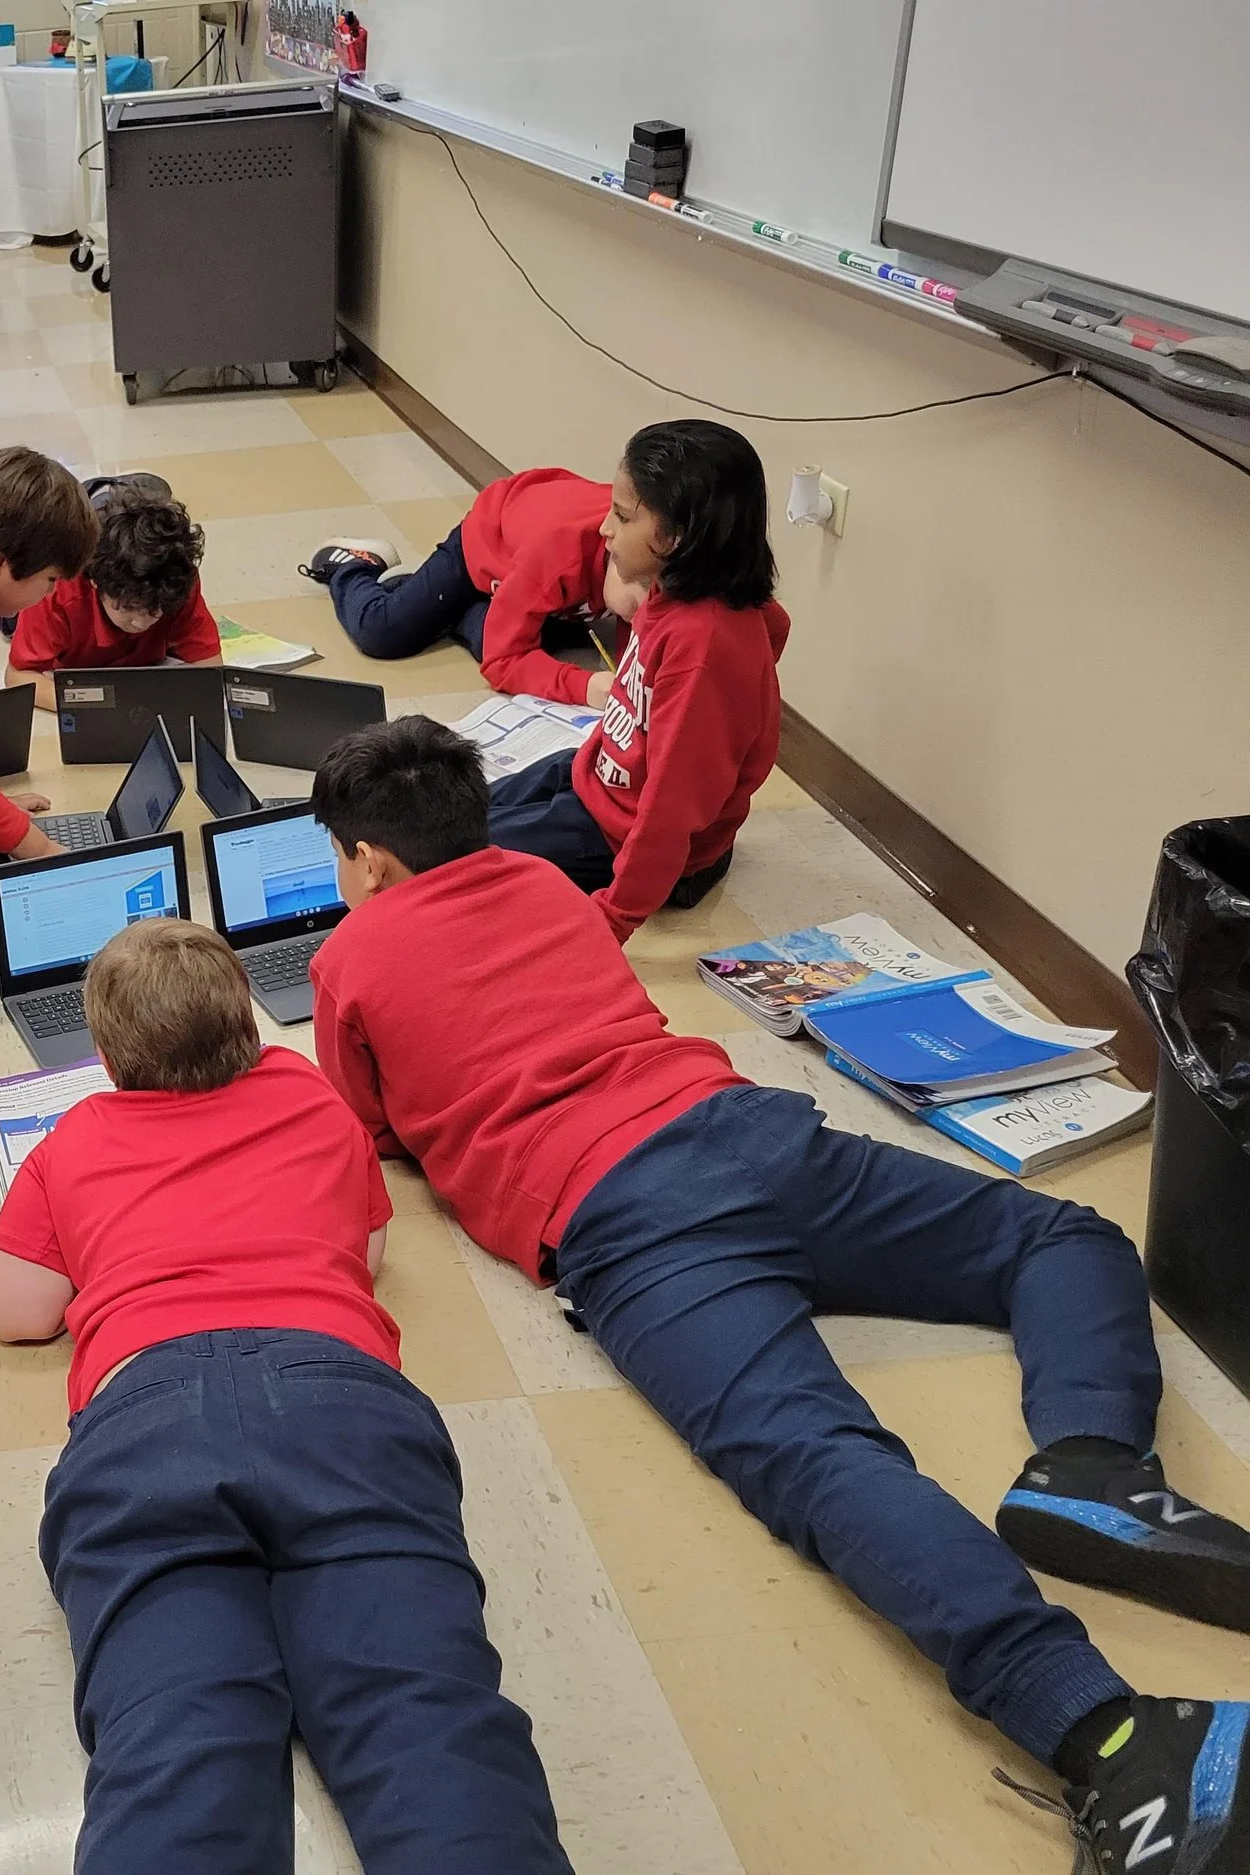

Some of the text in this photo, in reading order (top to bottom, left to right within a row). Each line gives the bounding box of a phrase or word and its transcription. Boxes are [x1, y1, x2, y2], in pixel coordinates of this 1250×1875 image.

[843, 935, 932, 980] myView
[905, 1032, 961, 1062] myView
[19, 1079, 46, 1090] Relevant
[46, 1073, 68, 1083] Details
[991, 1089, 1093, 1129] myView
[1032, 1104, 1098, 1131] LITERACY
[1128, 1490, 1205, 1524] N
[1118, 1795, 1174, 1871] N
